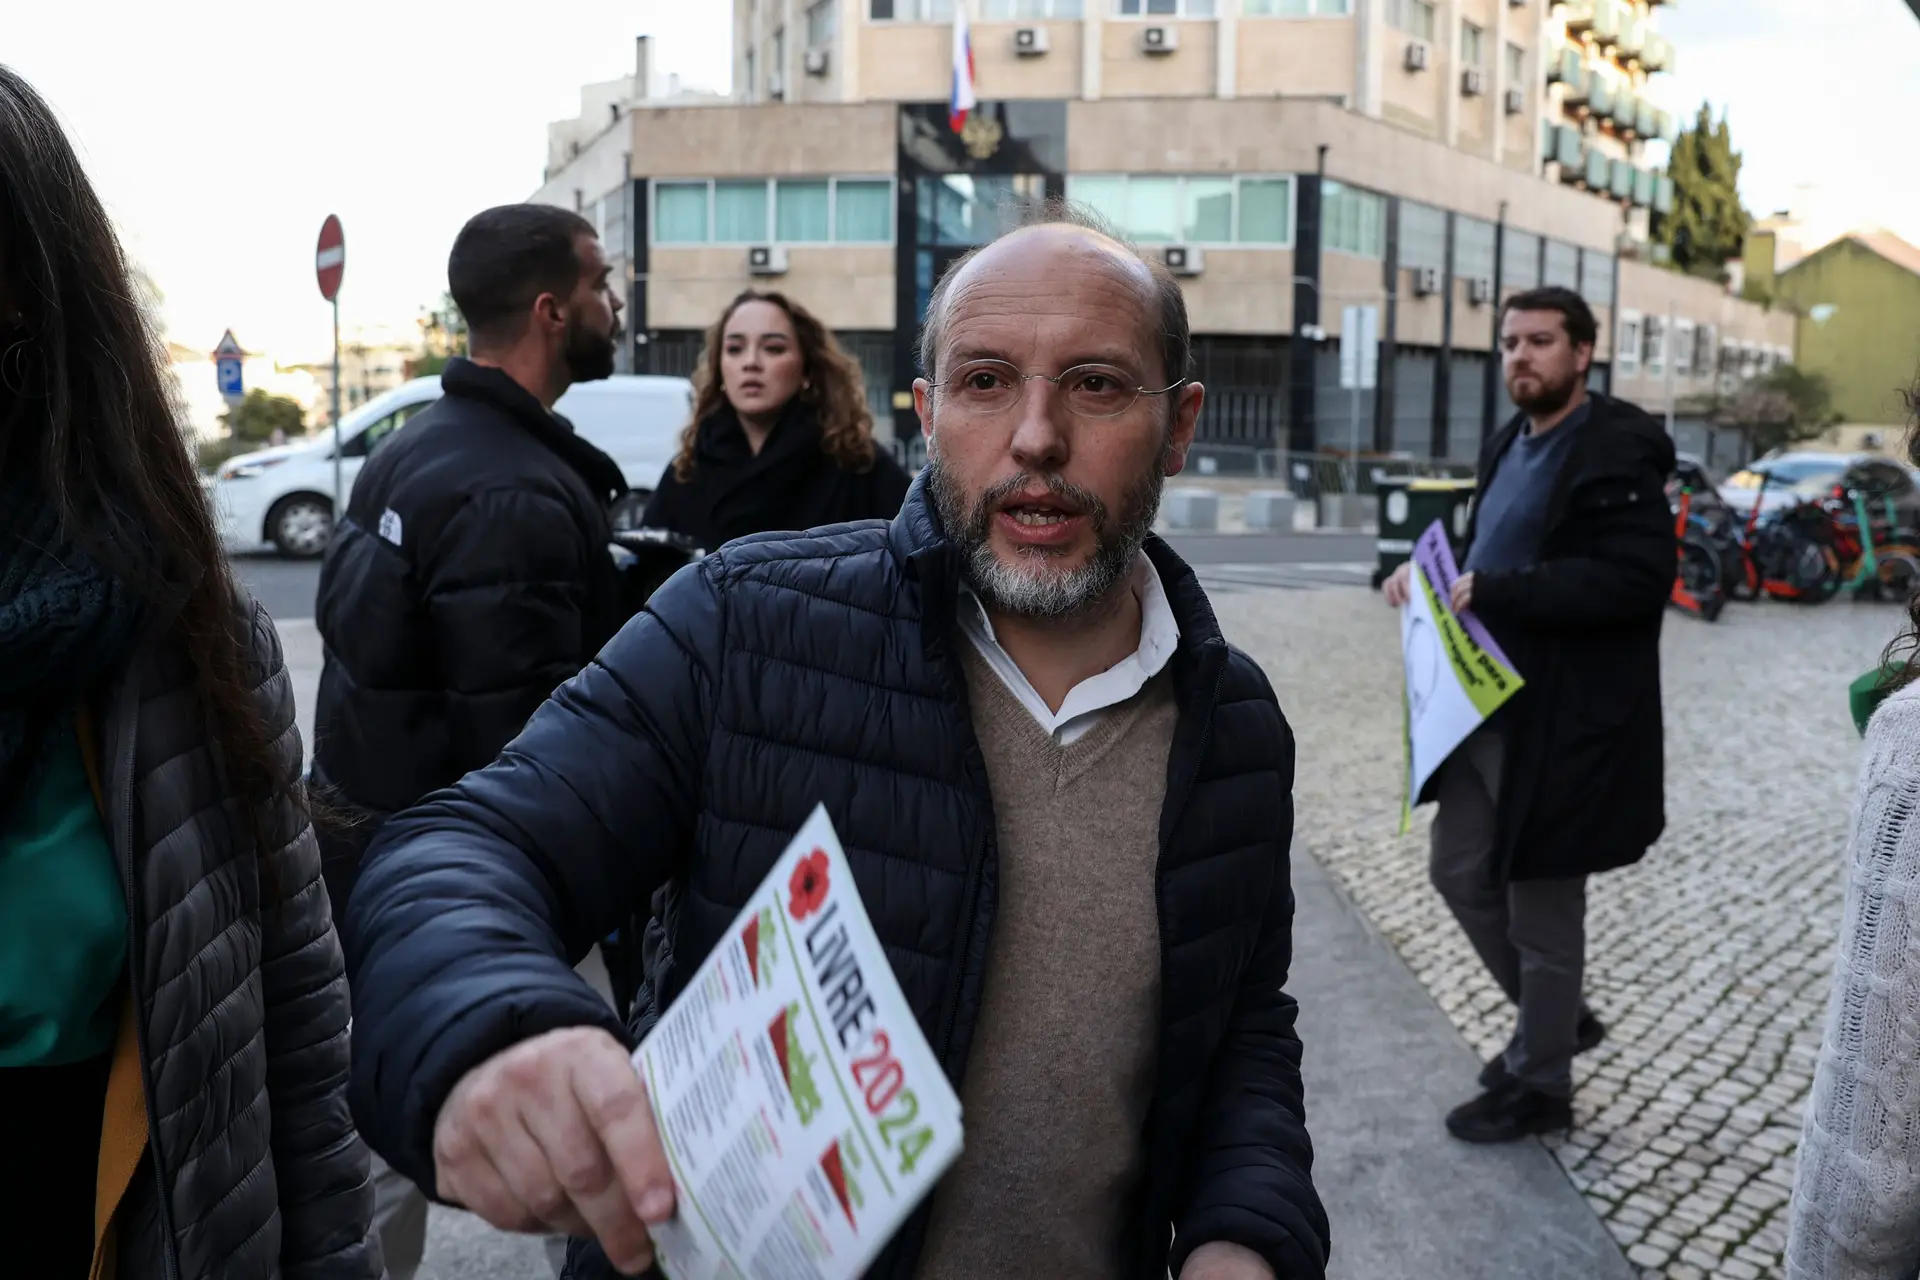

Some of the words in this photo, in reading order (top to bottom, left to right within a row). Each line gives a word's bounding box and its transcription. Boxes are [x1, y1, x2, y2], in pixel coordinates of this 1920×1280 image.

[219, 360, 240, 393] P
[1477, 653, 1507, 691] para
[850, 1029, 934, 1175] 2024
